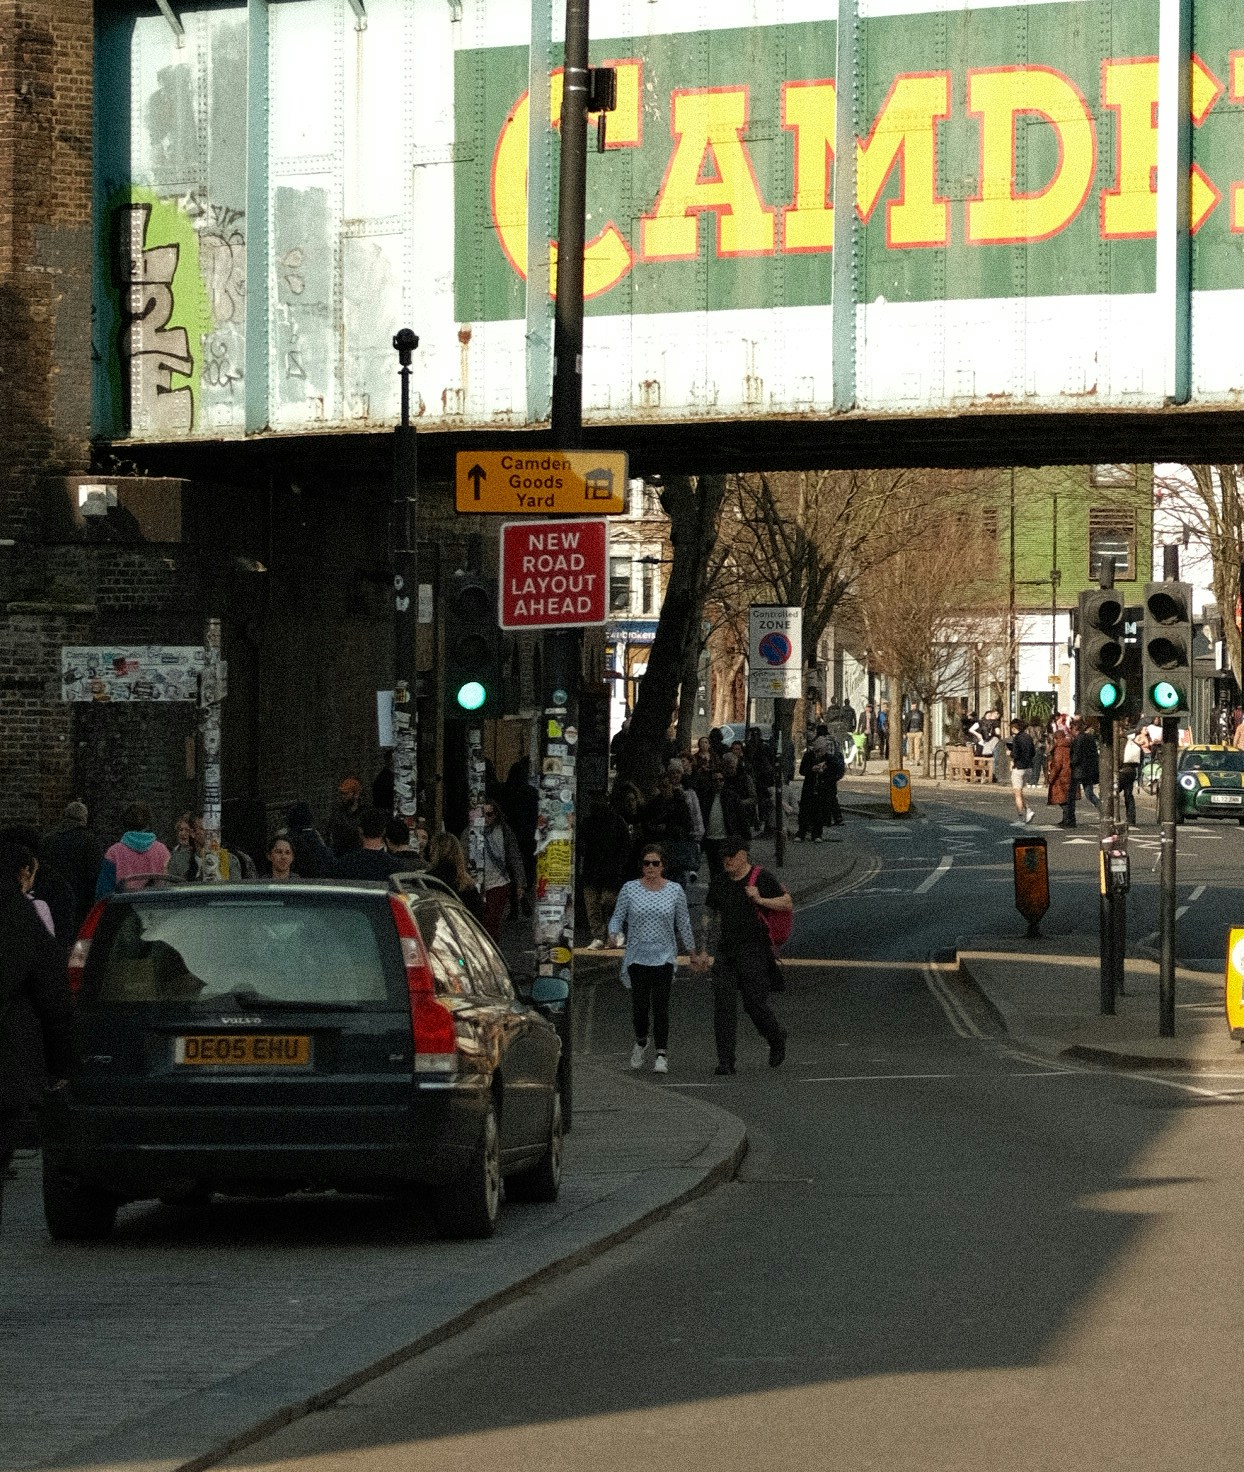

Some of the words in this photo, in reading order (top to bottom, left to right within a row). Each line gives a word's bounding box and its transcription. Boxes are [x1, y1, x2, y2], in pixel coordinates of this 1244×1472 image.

[501, 455, 572, 471] Camden
[509, 474, 563, 489] Goods
[516, 493, 555, 507] Yard
[528, 532, 580, 551] NEW
[522, 554, 585, 573] ROAD
[511, 575, 596, 595] LAYOUT
[513, 597, 592, 617] AHEAD
[759, 620, 791, 629] ZONE
[253, 1038, 299, 1059] EHU
